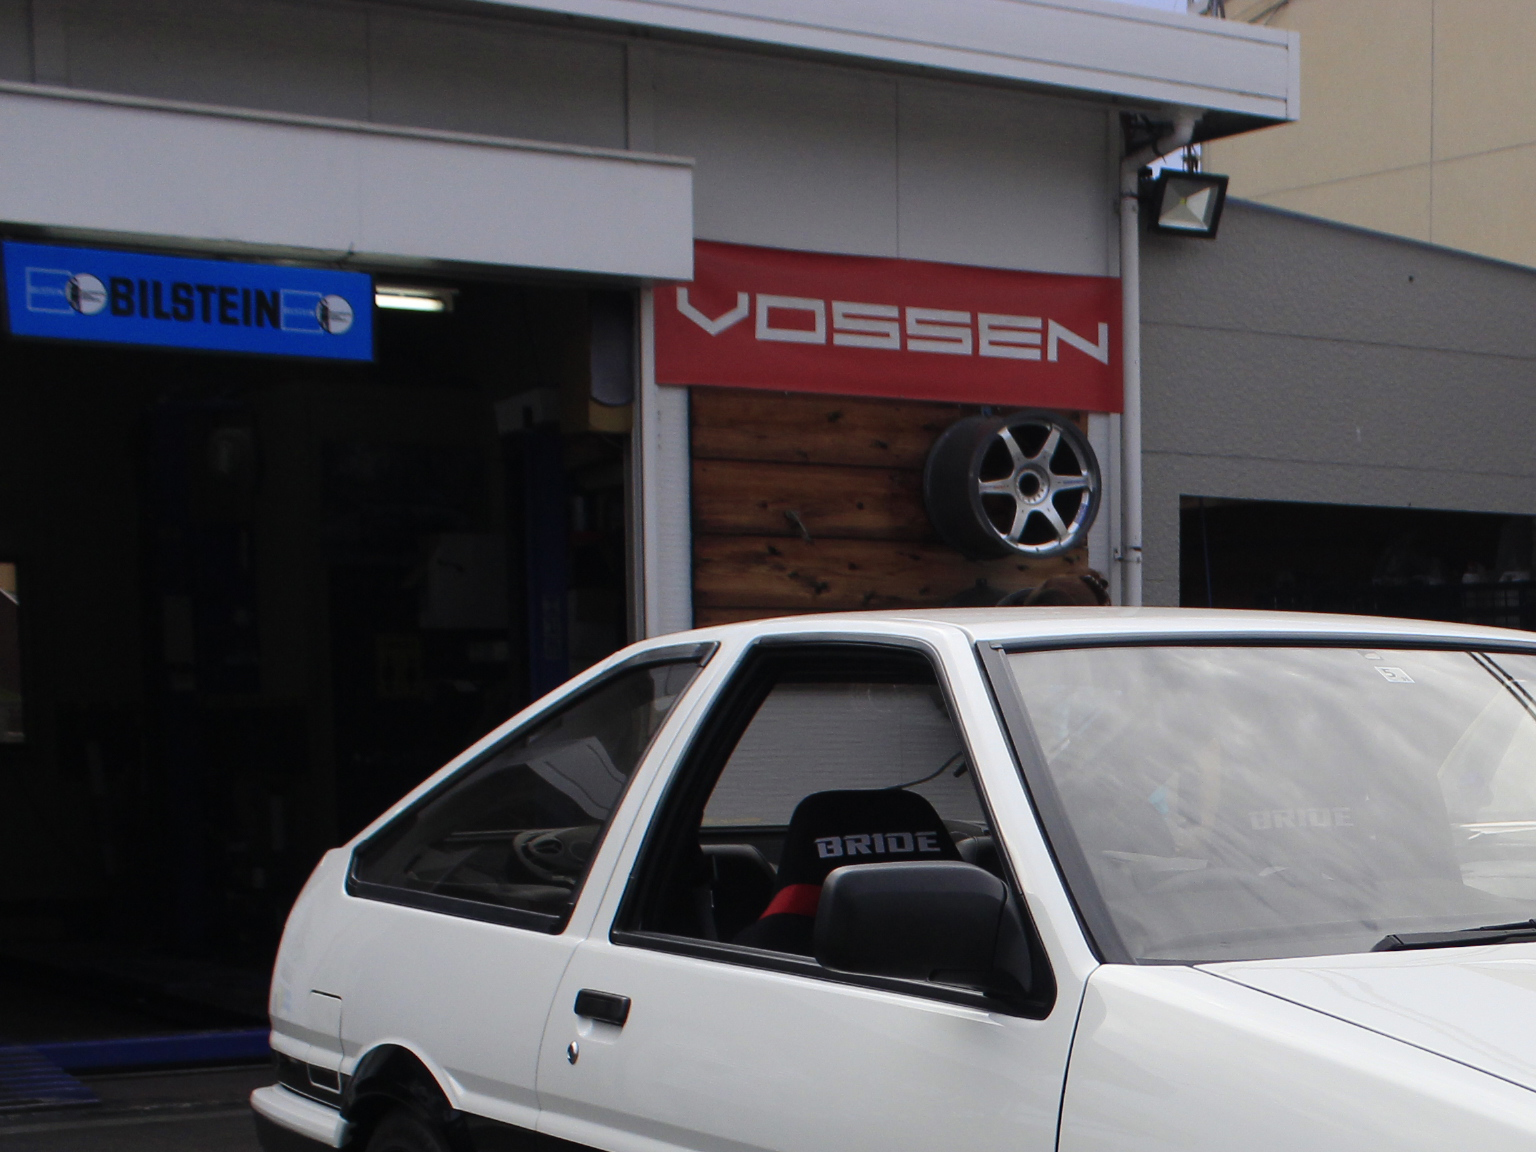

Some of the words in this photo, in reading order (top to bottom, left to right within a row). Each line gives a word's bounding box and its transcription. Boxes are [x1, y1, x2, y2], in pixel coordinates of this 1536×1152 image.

[109, 276, 281, 330] BILSTEIN
[675, 286, 1109, 365] VOSSEN
[815, 831, 942, 859] BRIDE
